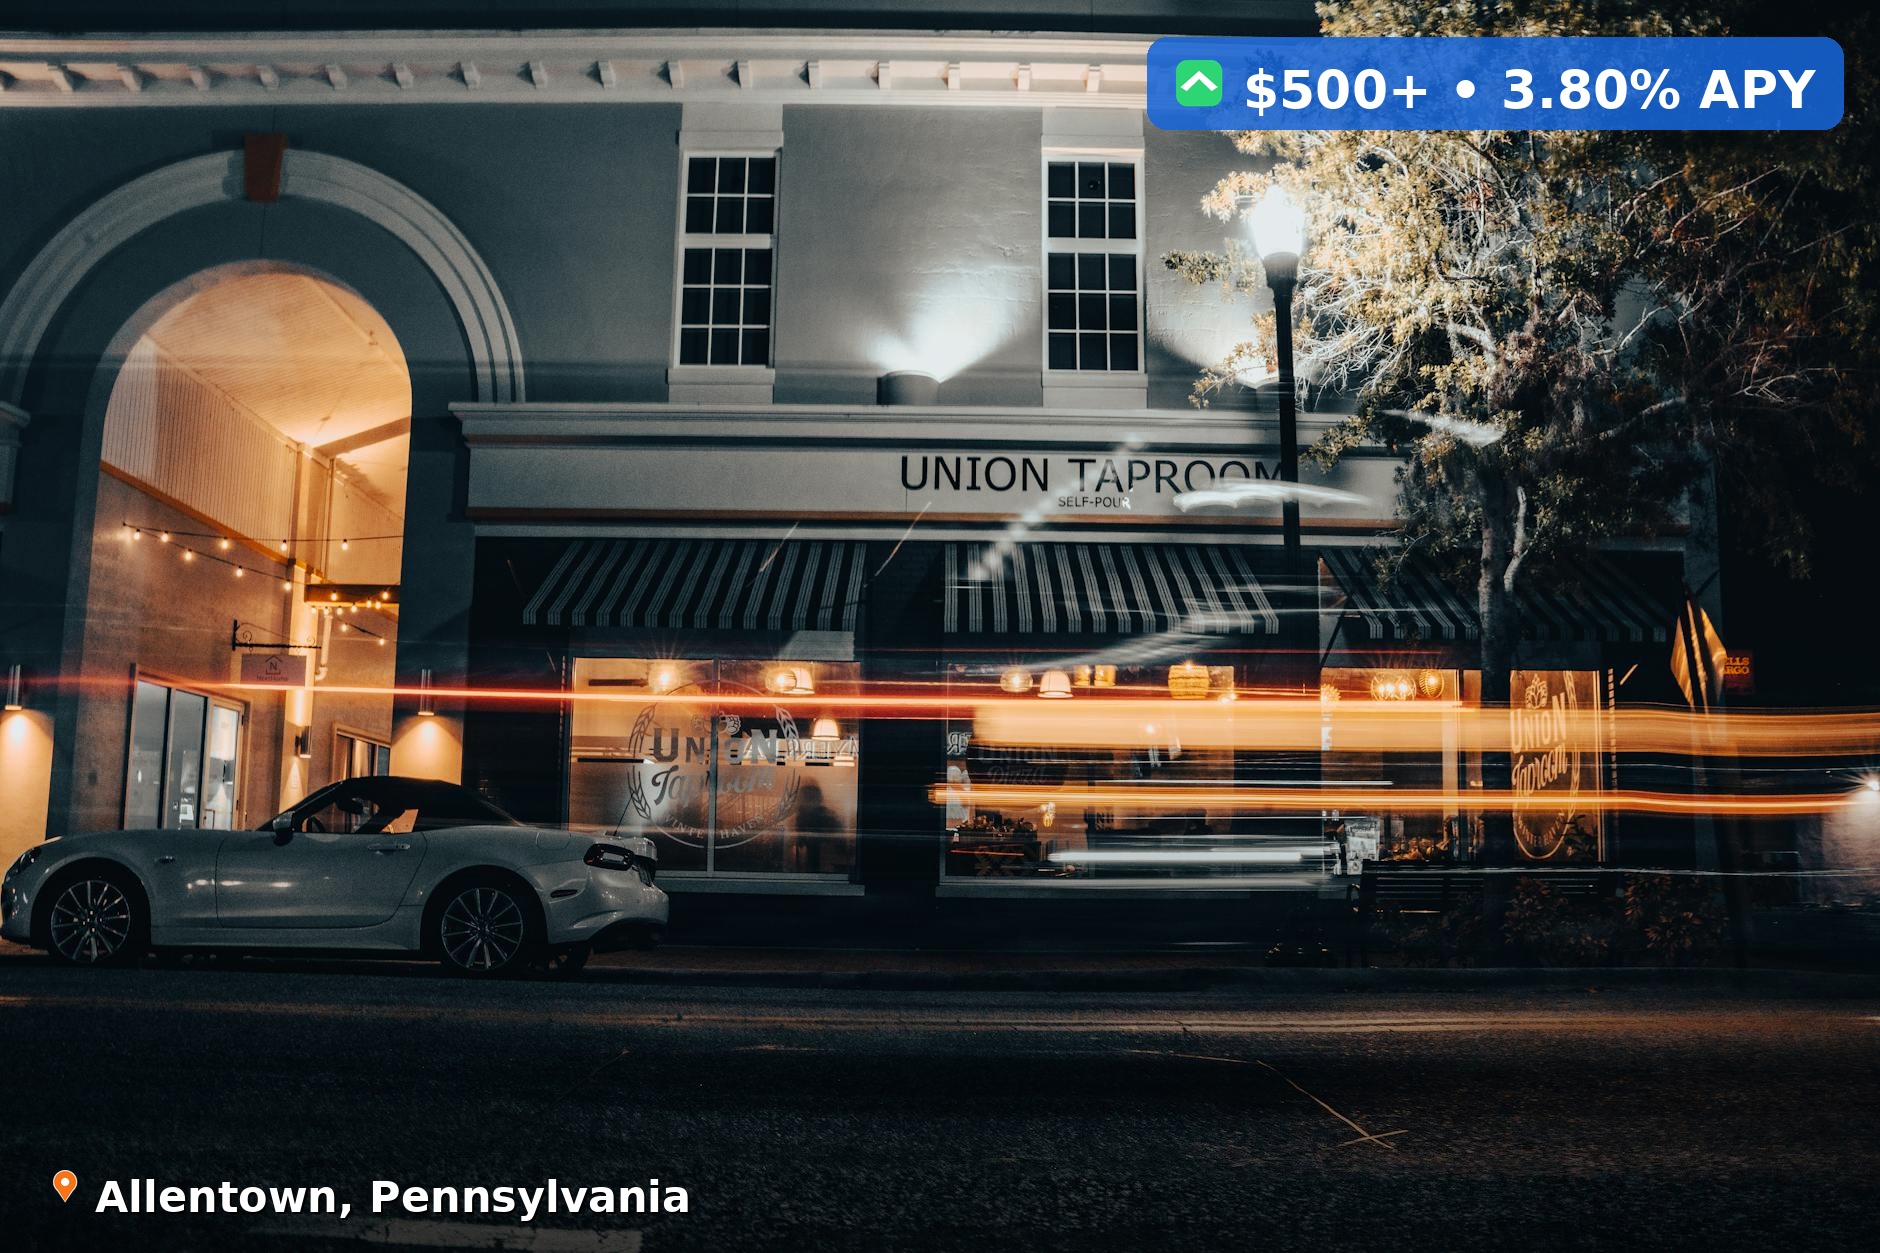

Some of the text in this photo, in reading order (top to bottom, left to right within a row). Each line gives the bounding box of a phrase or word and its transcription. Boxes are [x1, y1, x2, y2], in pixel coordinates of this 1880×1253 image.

[901, 455, 1048, 491] UNION
[1510, 691, 1567, 754] UNION
[652, 727, 778, 764] UNON
